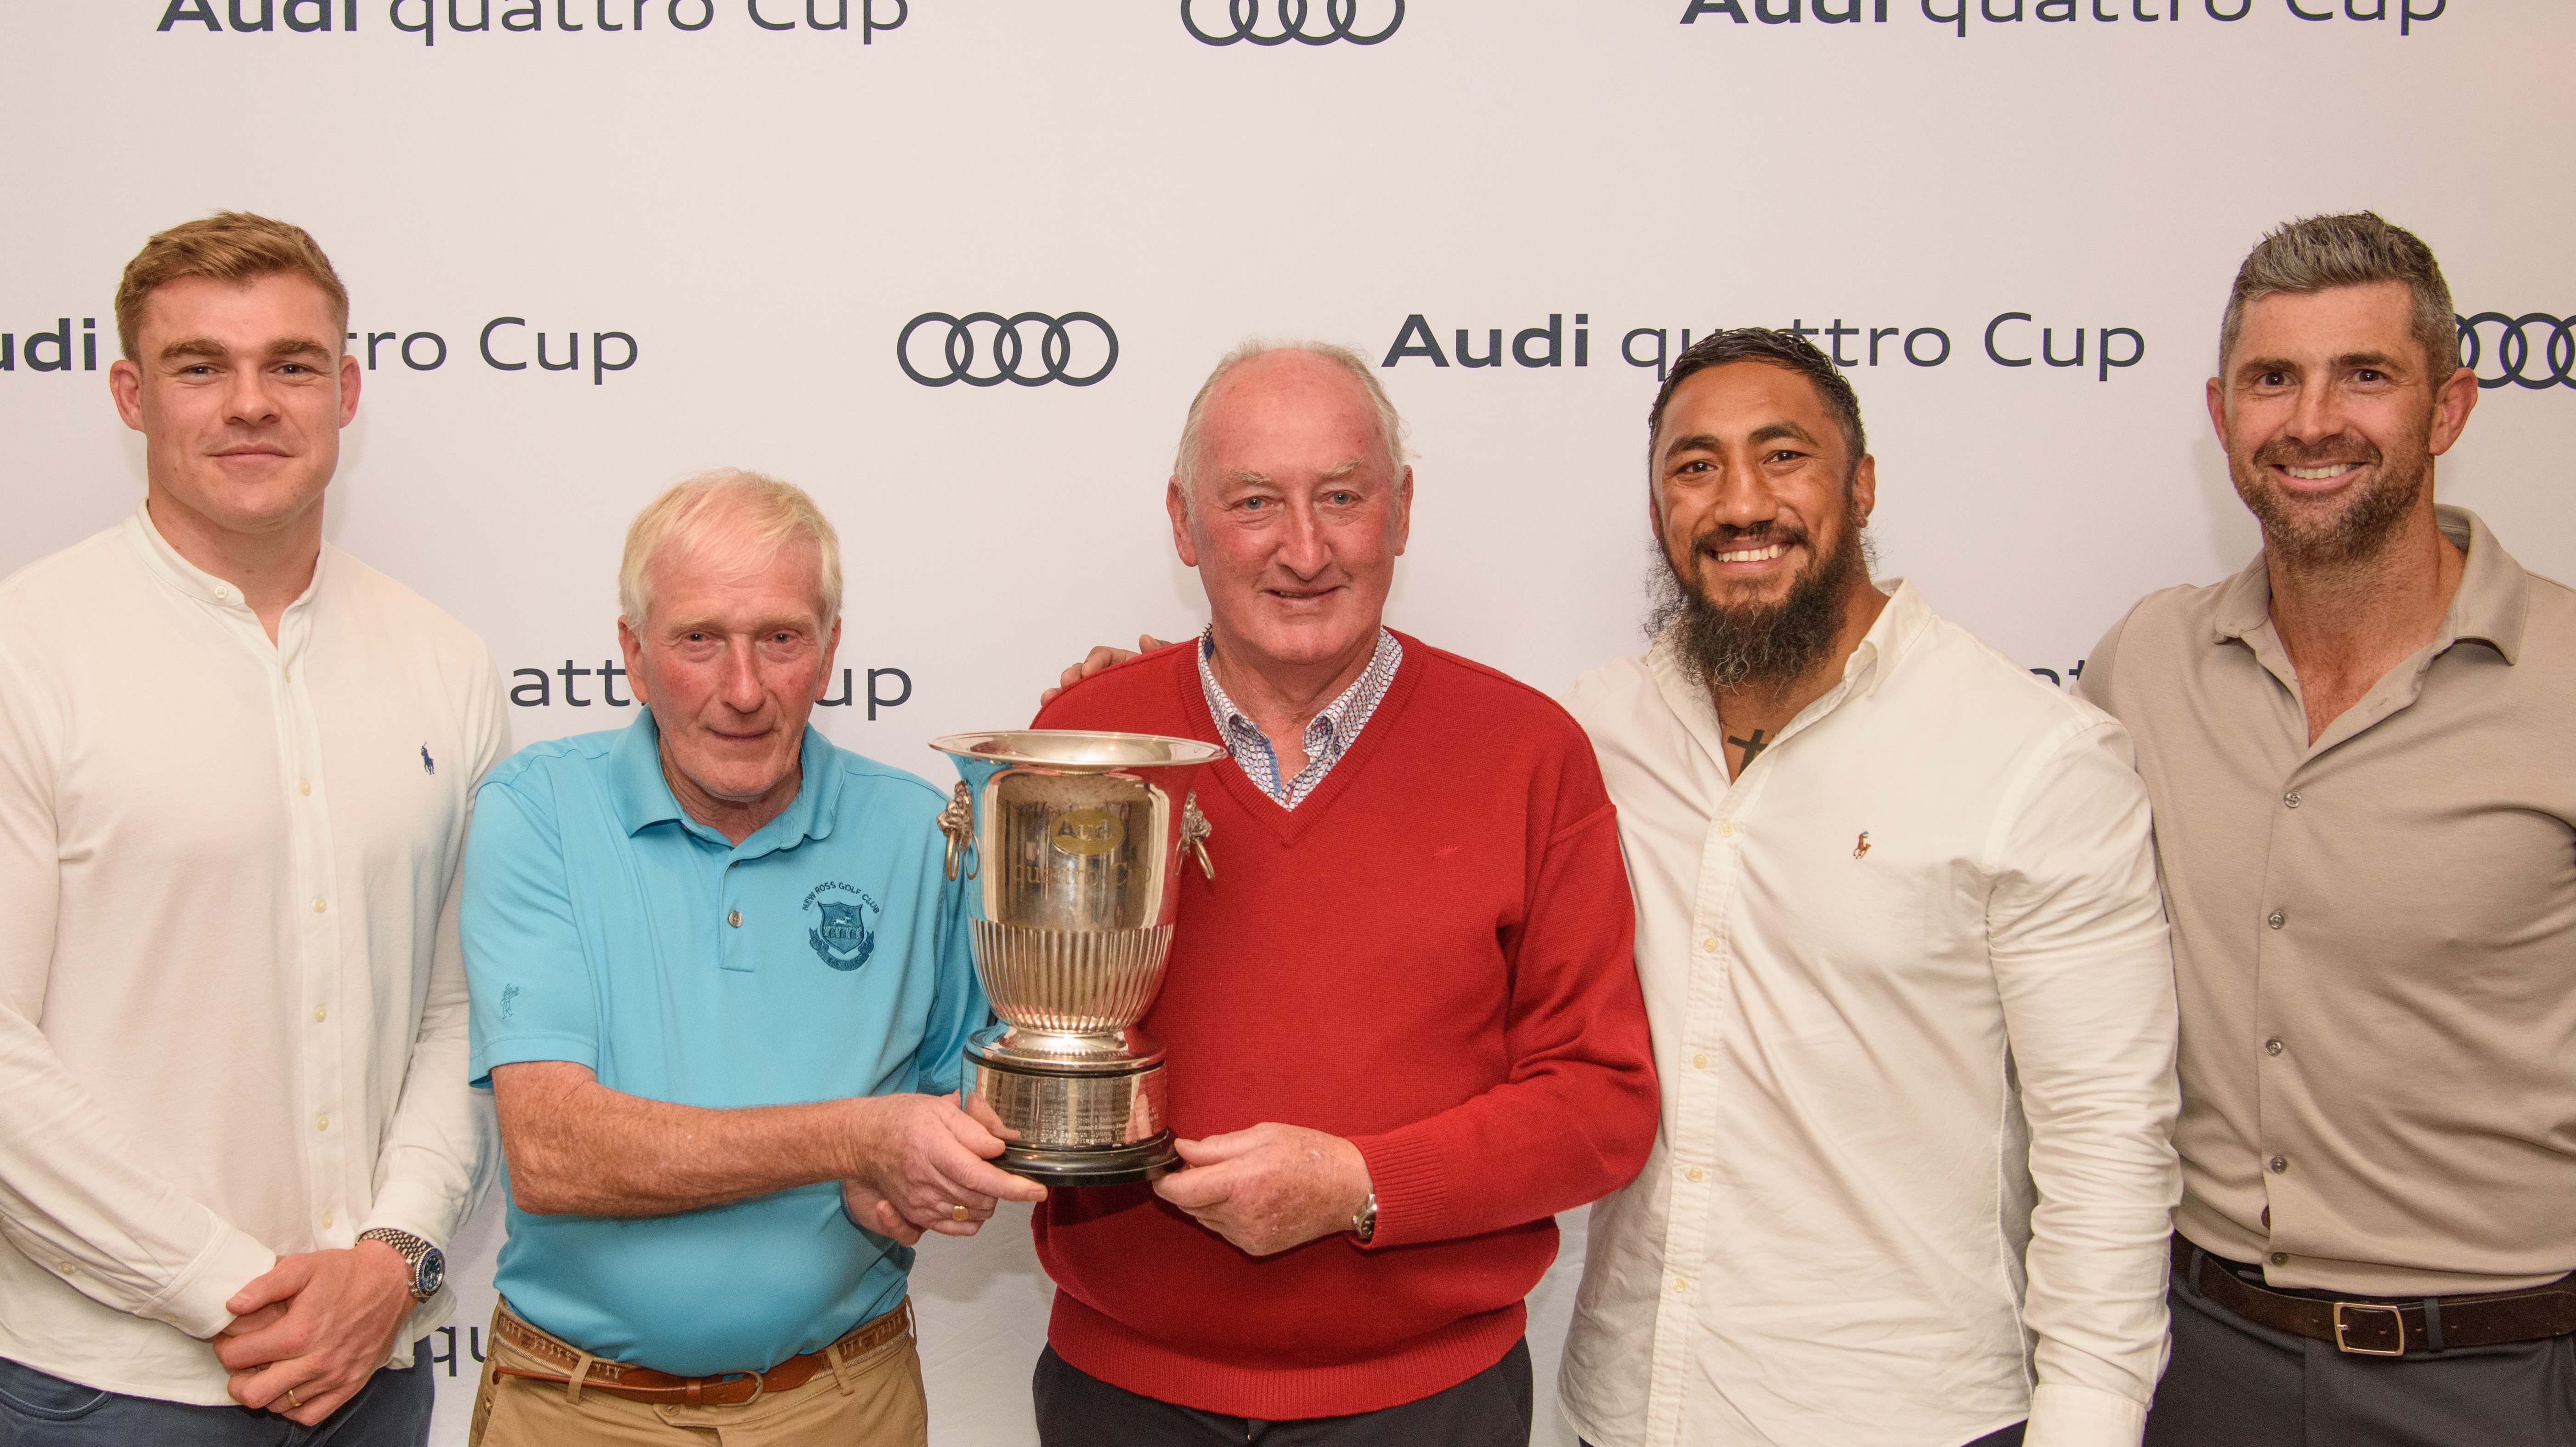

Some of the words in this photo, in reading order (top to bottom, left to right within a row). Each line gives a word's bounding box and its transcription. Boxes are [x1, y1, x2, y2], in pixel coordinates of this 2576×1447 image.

[157, 0, 357, 33] Audi
[748, 0, 908, 45] Cup
[480, 317, 638, 385] Cup
[1381, 314, 1588, 368] Audi
[1984, 312, 2145, 382] Cup
[802, 891, 816, 911] NEW
[815, 881, 836, 894] ROSS
[838, 882, 862, 894] GOLF
[862, 893, 880, 914] CLUB
